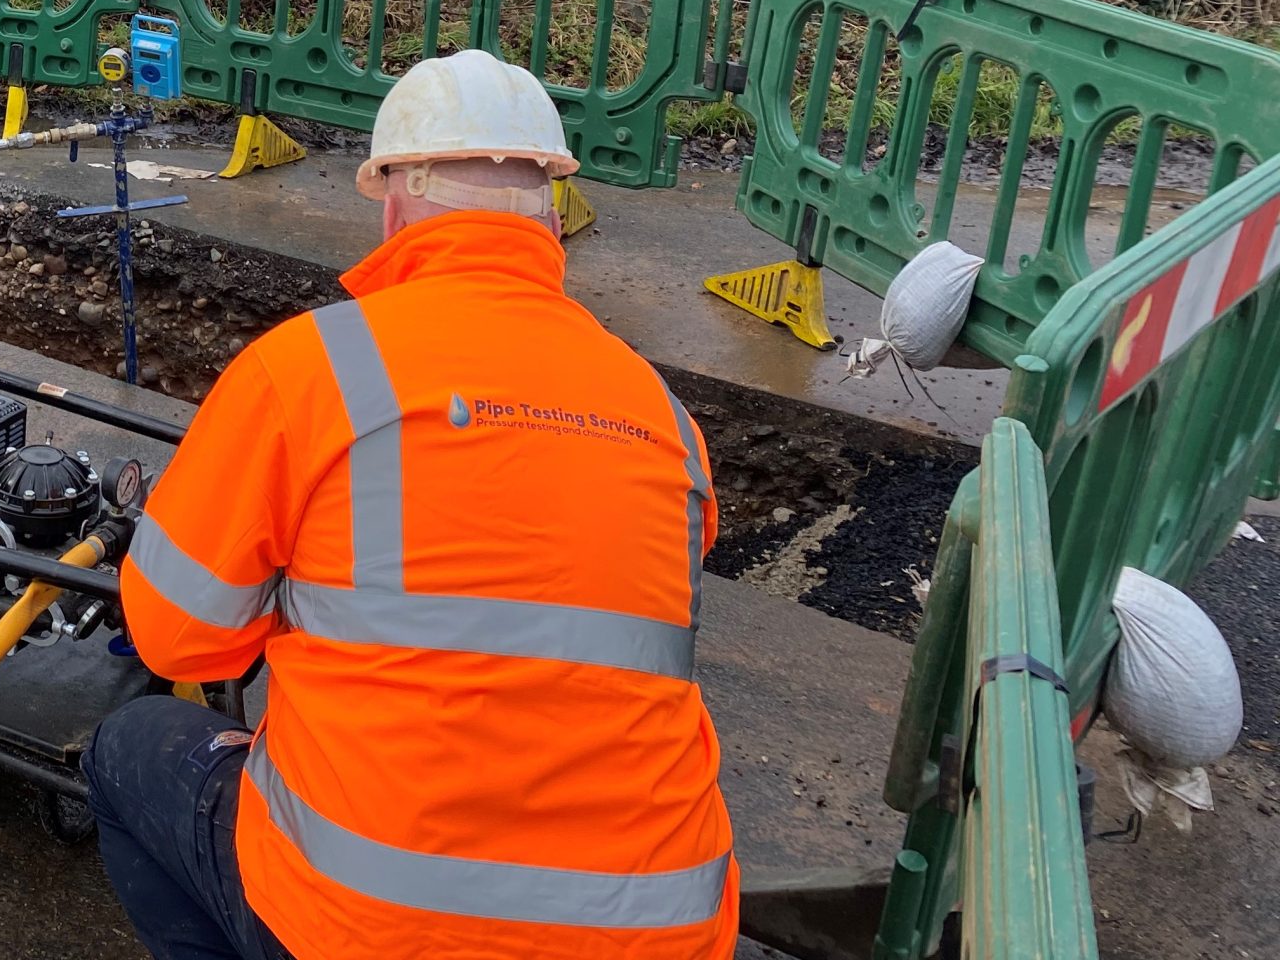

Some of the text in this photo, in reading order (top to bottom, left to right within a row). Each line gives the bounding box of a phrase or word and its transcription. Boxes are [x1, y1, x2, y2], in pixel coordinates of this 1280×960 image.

[474, 399, 516, 418] Pipe
[519, 403, 586, 427] Testing
[588, 413, 651, 441] Services
[476, 418, 524, 429] Pressure
[526, 421, 562, 435] testing
[562, 427, 581, 435] and
